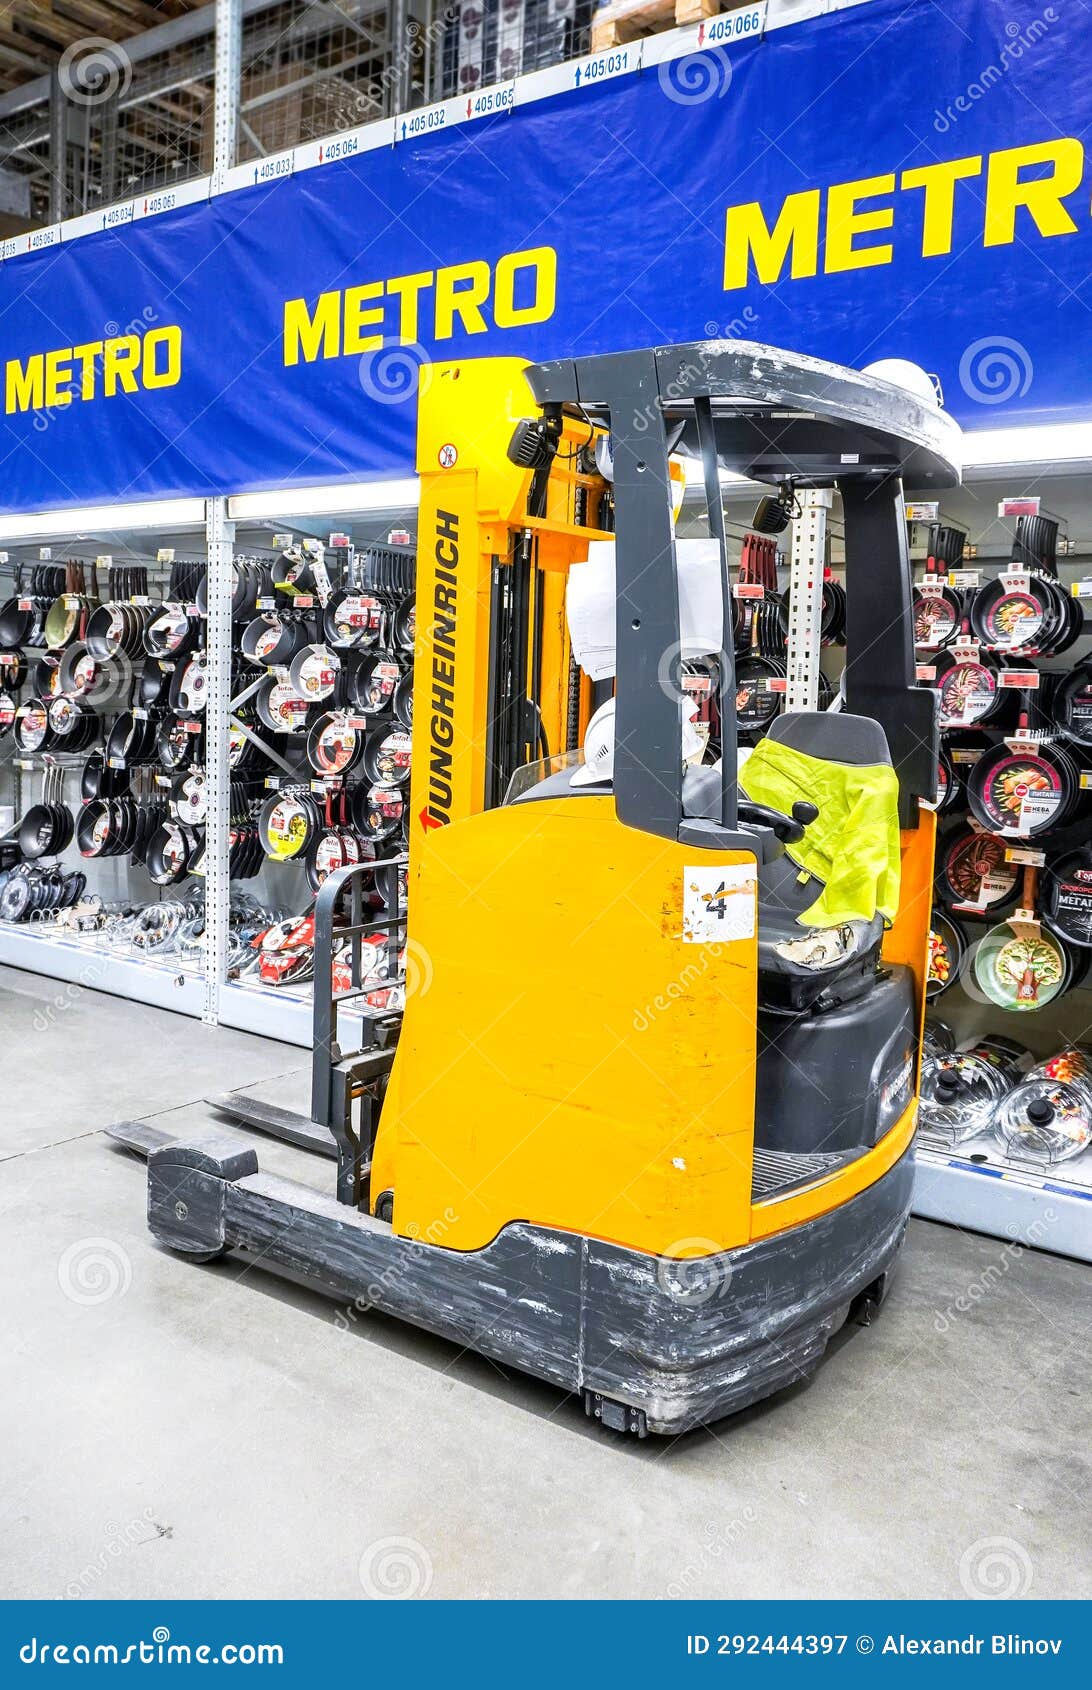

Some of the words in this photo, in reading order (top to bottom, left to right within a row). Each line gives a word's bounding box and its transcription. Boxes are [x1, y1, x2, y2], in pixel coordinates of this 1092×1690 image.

[584, 52, 628, 80] 405/031
[708, 12, 760, 41] 405/066
[722, 137, 1092, 292] METR
[284, 246, 557, 366] METRO
[5, 324, 182, 415] METRO
[425, 508, 459, 828] JUNGHEINRICH
[706, 881, 727, 919] 4
